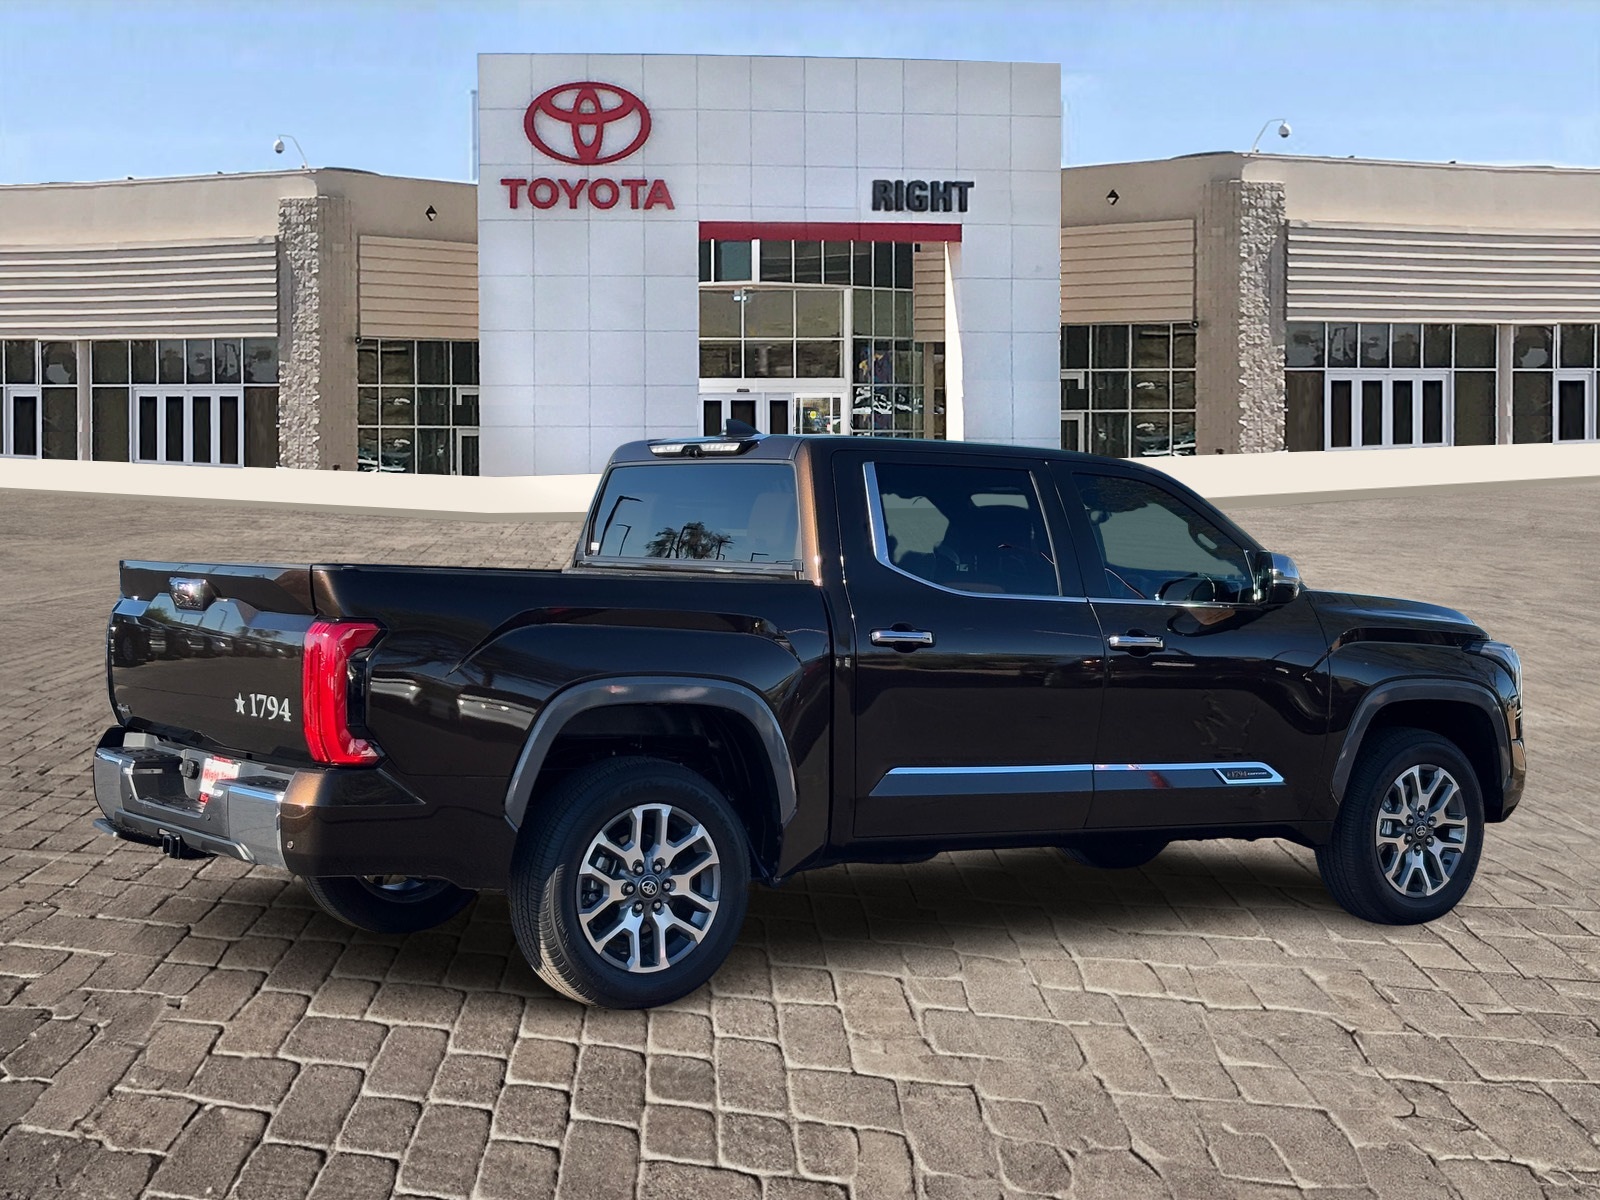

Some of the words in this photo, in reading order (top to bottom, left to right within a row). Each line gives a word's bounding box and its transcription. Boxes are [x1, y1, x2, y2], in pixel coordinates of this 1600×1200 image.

[500, 177, 675, 210] TOYOTA
[872, 179, 975, 212] RIGHT
[249, 693, 291, 722] 1794
